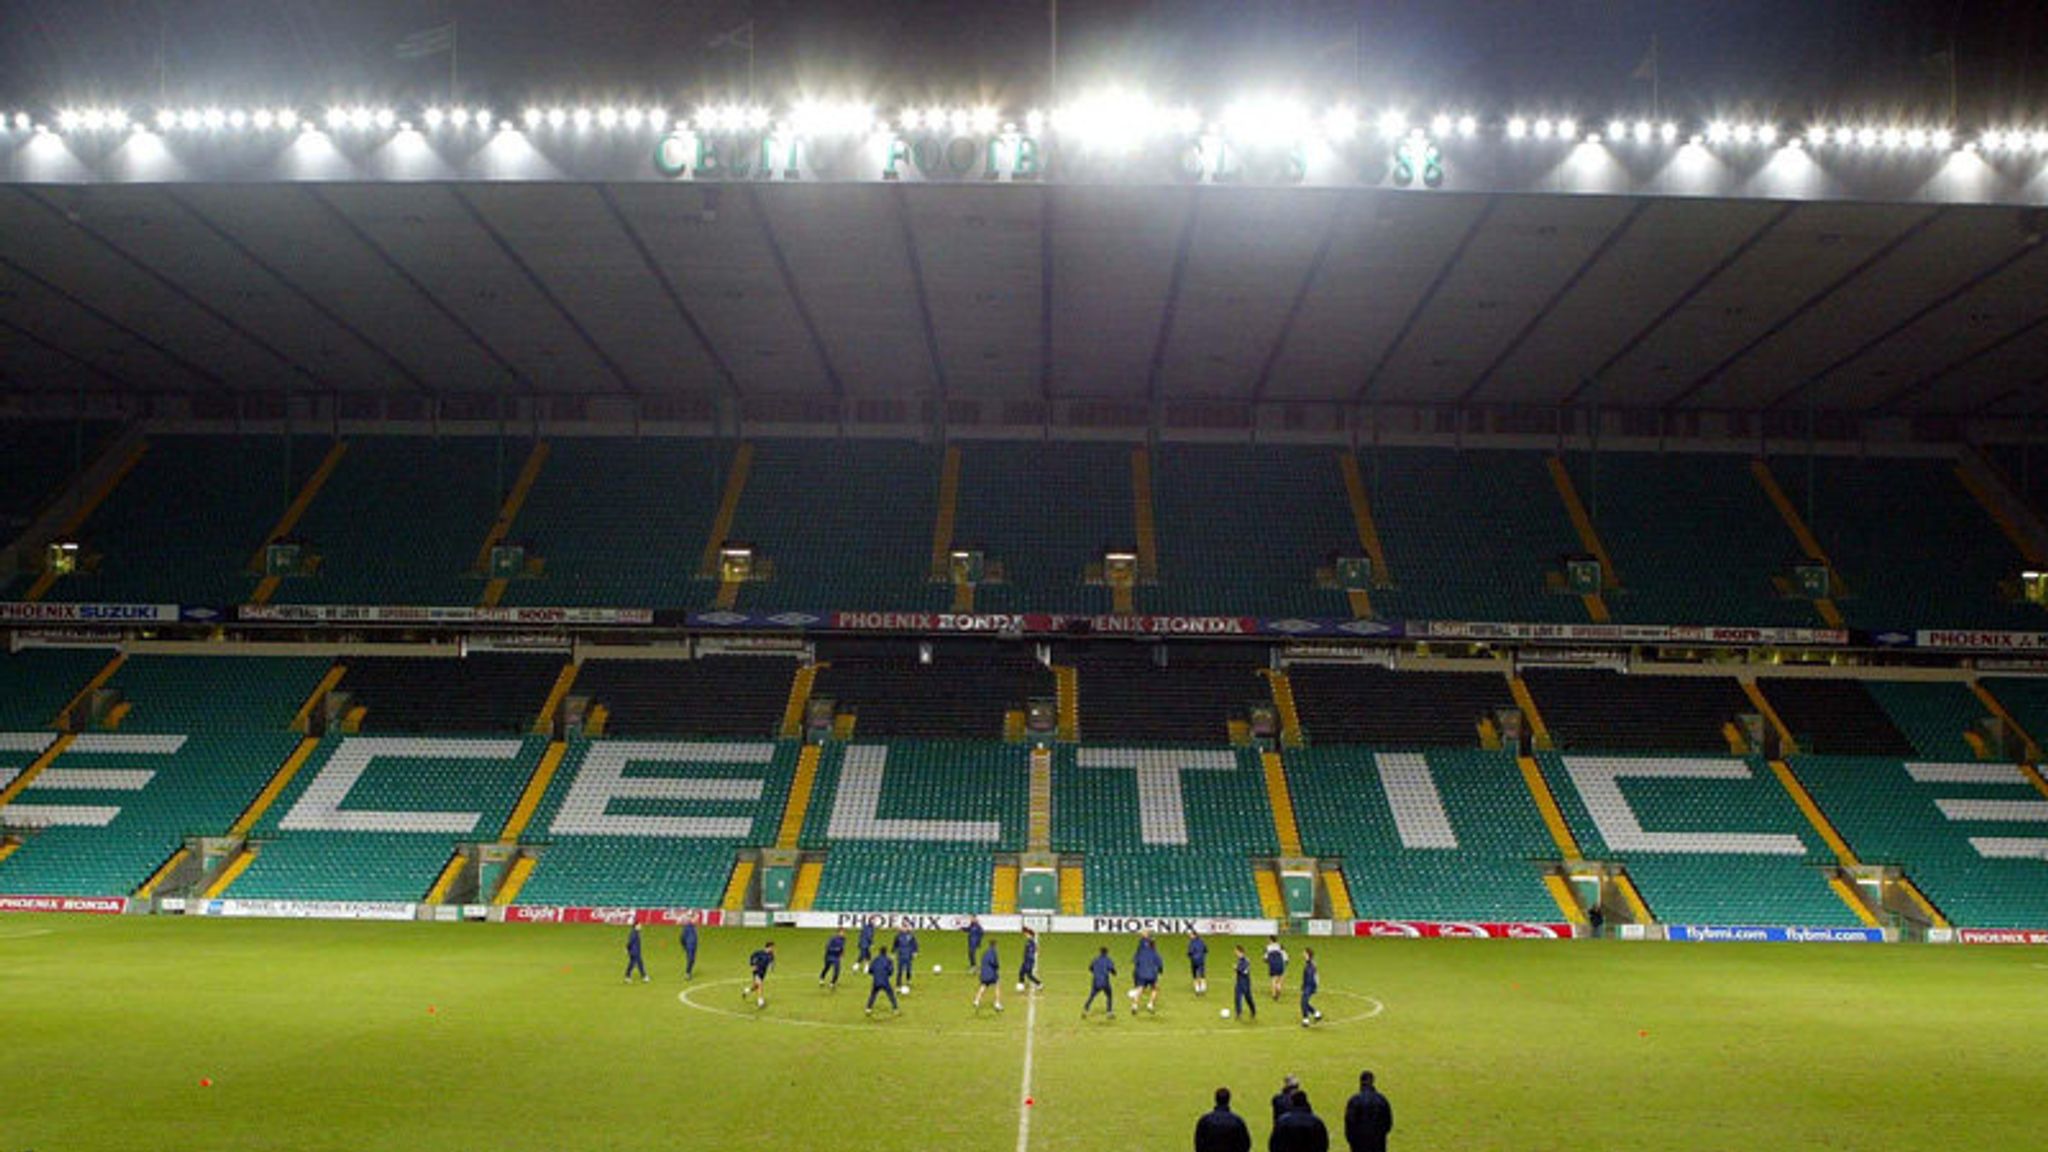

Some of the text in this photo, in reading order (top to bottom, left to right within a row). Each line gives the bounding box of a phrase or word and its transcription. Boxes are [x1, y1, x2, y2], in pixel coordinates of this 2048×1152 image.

[79, 604, 157, 618] SUZUKI
[839, 613, 929, 629] PHOENIX
[1151, 619, 1242, 634] HONDA
[1929, 633, 2012, 647] PHOENIX
[63, 901, 119, 911] HONDA
[345, 904, 407, 914] EXCHANGE
[836, 912, 941, 929] PHOENIX
[1093, 918, 1197, 934] PHOENIX
